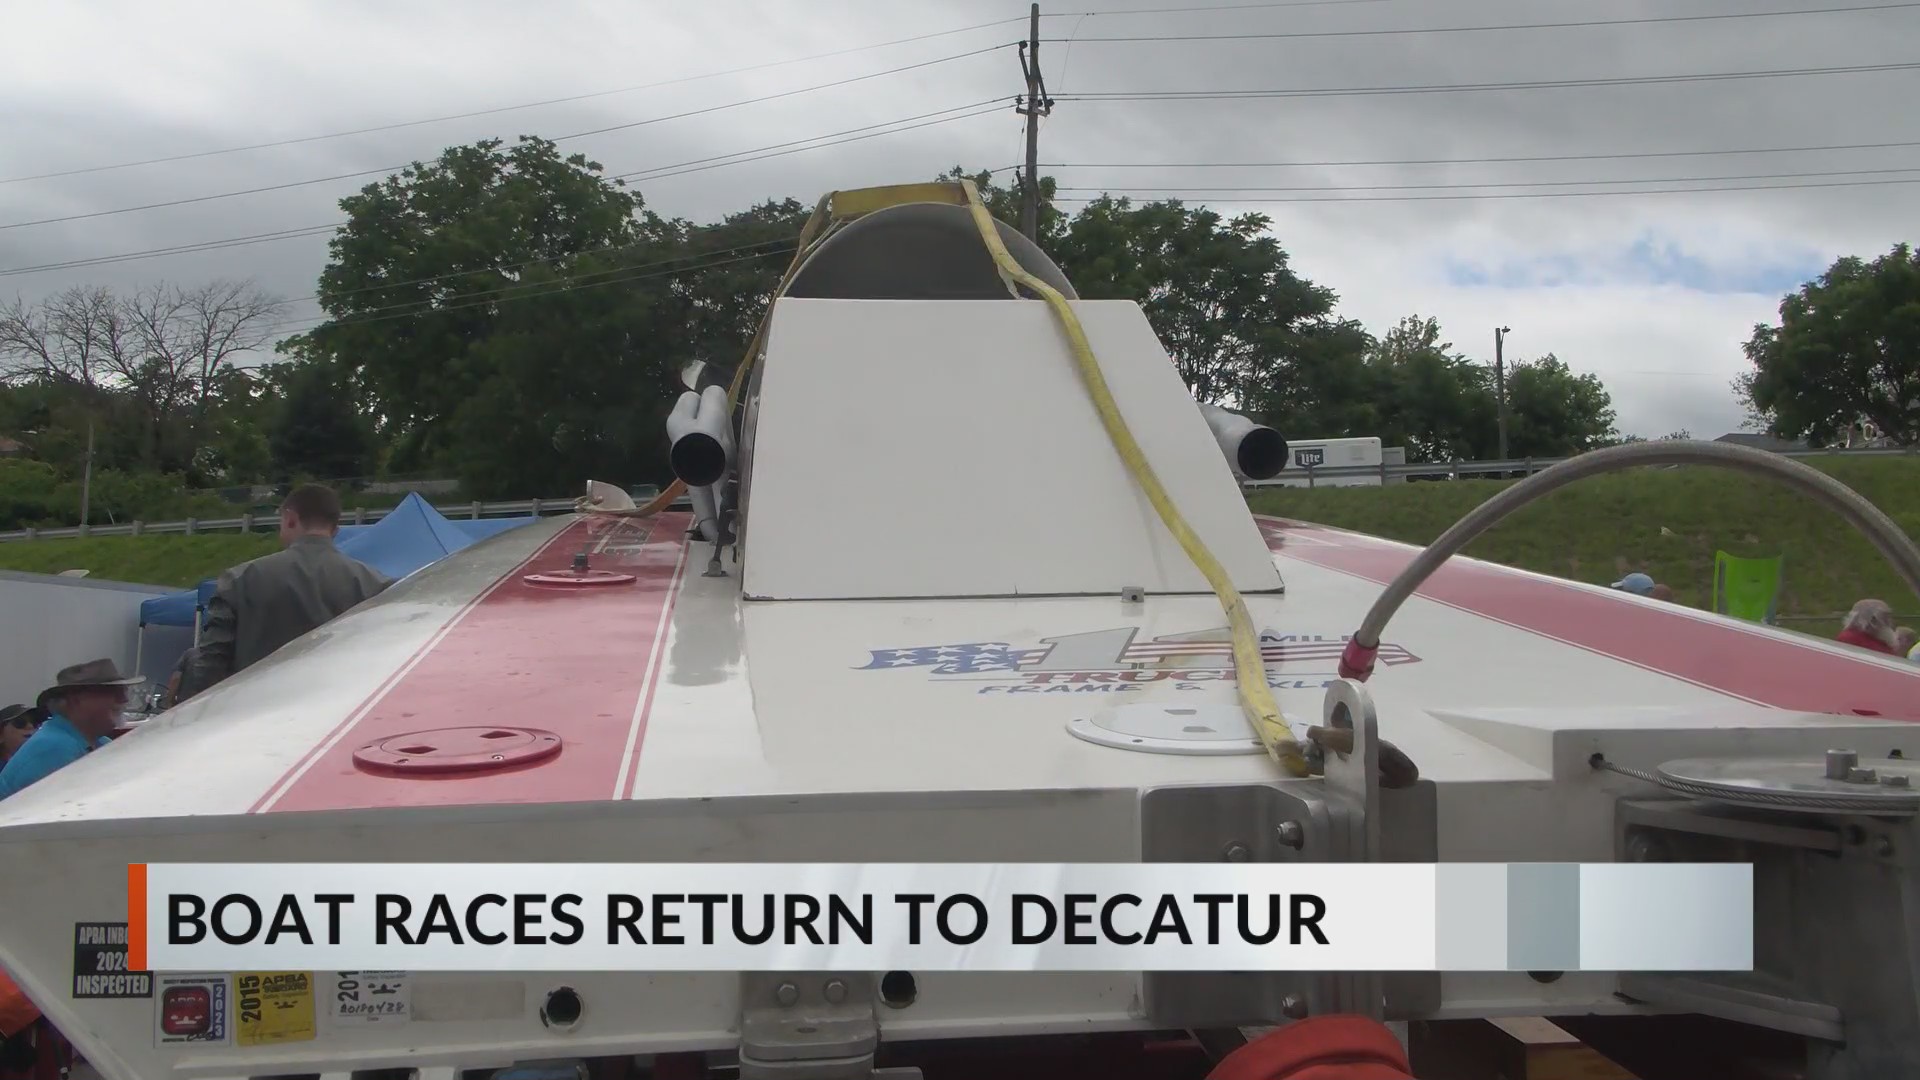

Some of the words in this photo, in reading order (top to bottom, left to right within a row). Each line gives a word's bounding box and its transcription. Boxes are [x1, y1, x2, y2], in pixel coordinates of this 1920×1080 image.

[1301, 453, 1320, 465] Lite
[977, 683, 1144, 694] FRAME
[1175, 682, 1204, 690] &
[79, 926, 106, 945] APBA
[77, 975, 149, 995] INSPECTED
[262, 973, 308, 986] APBA
[239, 975, 262, 1024] 2015
[215, 986, 224, 1037] 2023
